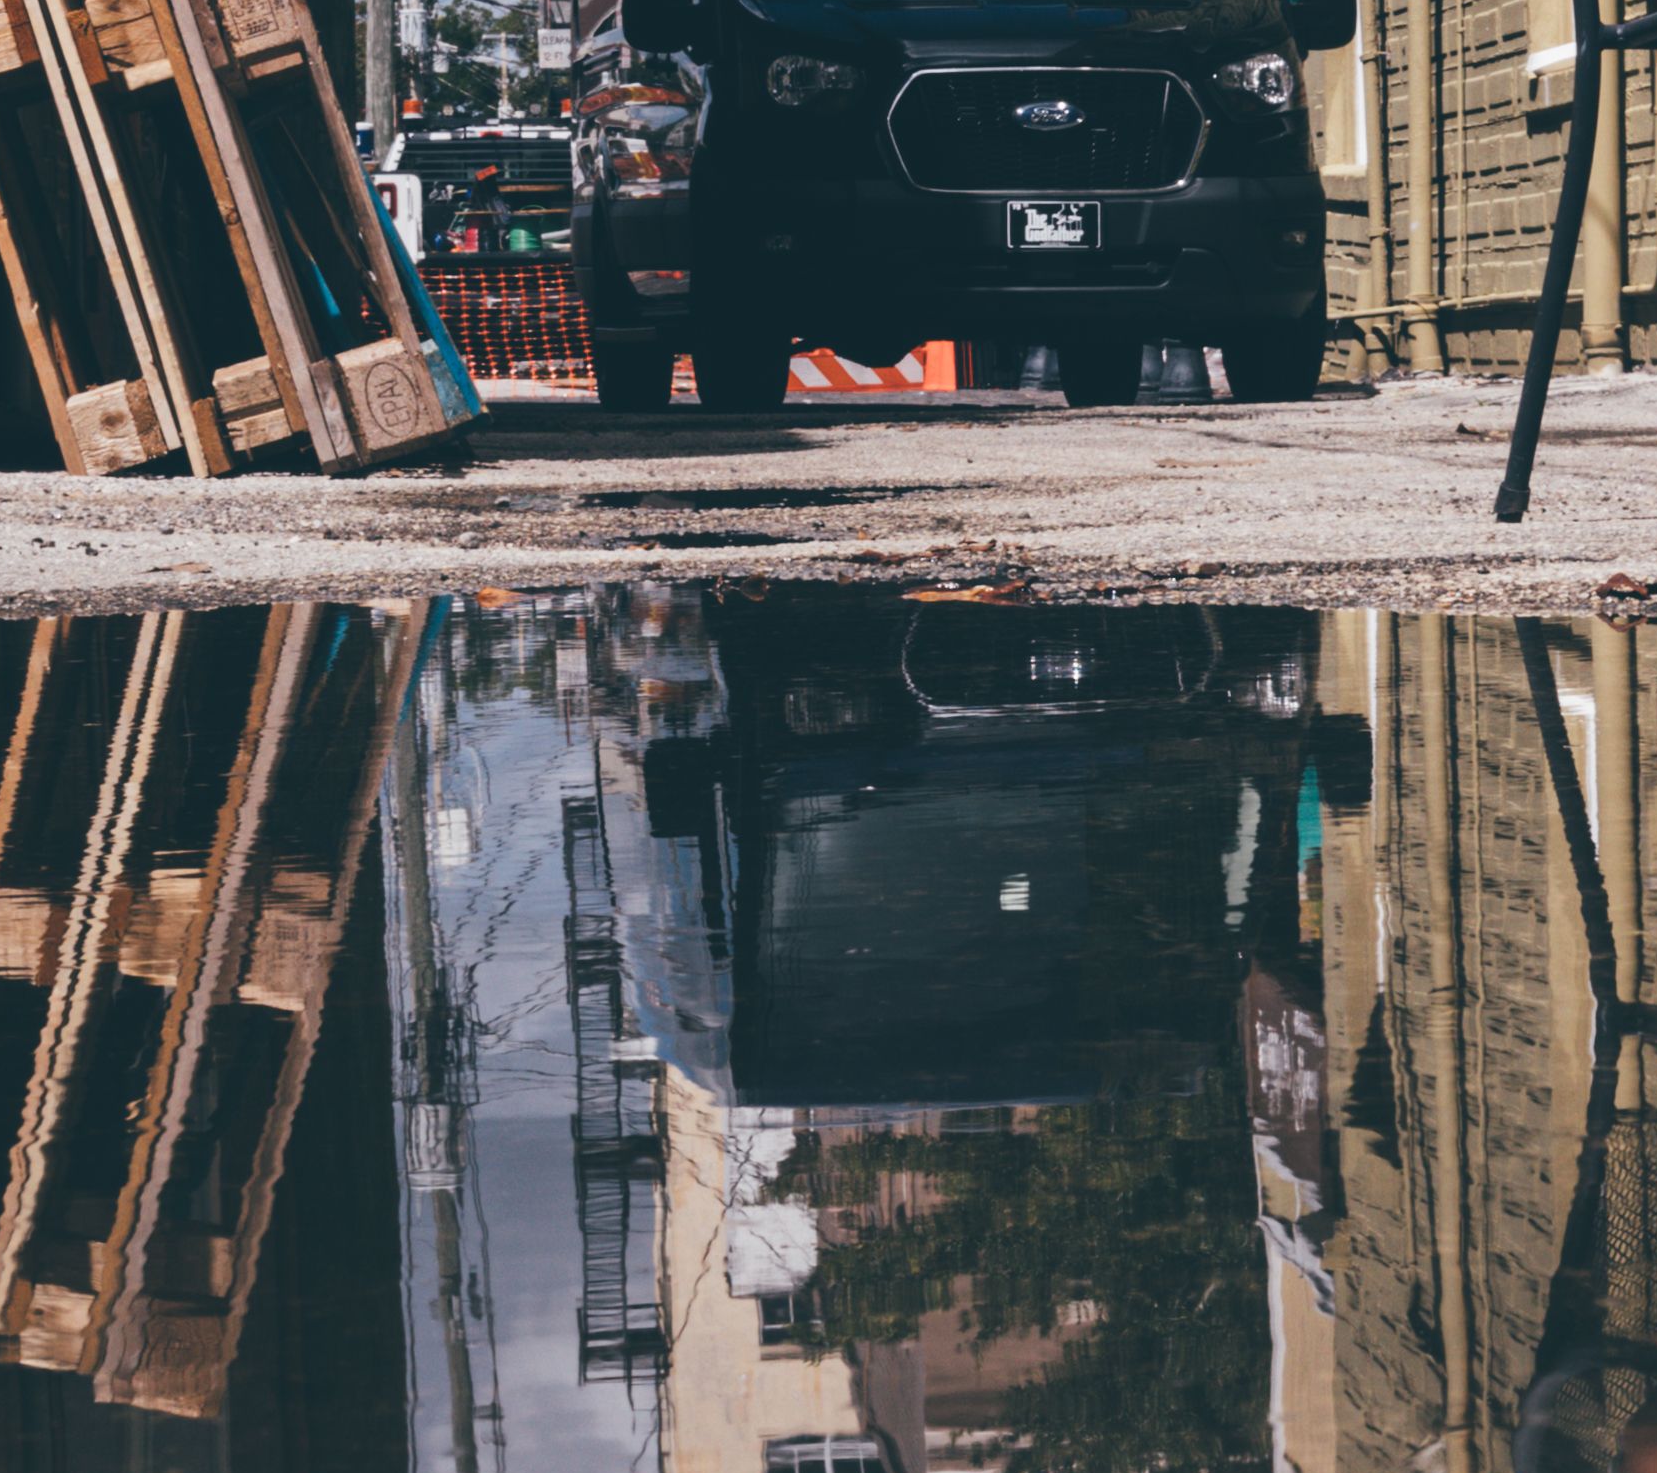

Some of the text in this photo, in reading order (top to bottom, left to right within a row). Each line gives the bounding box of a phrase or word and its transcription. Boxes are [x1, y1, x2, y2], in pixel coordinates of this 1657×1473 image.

[1025, 208, 1048, 226] The
[1025, 224, 1084, 242] Godfather
[374, 379, 411, 427] EPAL
